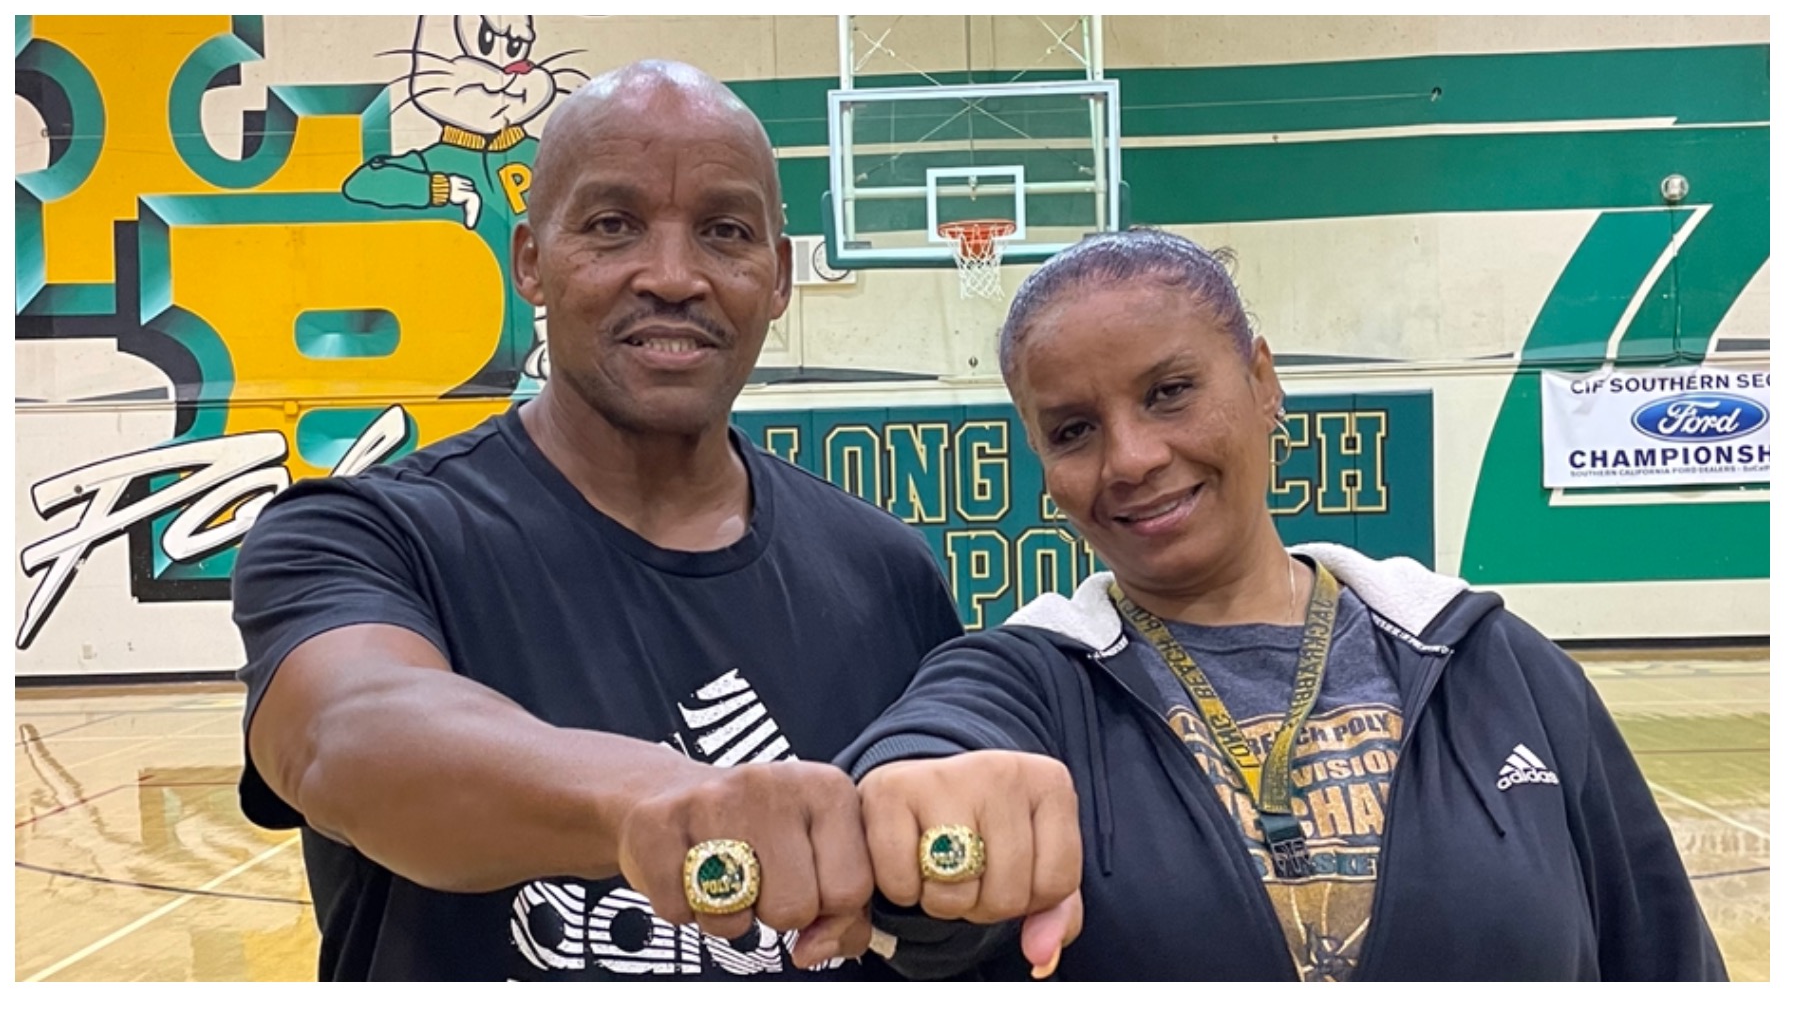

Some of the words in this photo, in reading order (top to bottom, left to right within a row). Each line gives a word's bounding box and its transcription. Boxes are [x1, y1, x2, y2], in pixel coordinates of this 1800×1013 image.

[1570, 379, 1606, 395] CIF
[1609, 374, 1730, 393] SOUTHERN
[1657, 400, 1743, 435] Ford
[1568, 443, 1770, 469] CHAMPIONSH
[947, 528, 1074, 630] PO
[1335, 713, 1391, 741] POLY
[1292, 748, 1400, 787] VISIO
[1496, 768, 1560, 791] adidas
